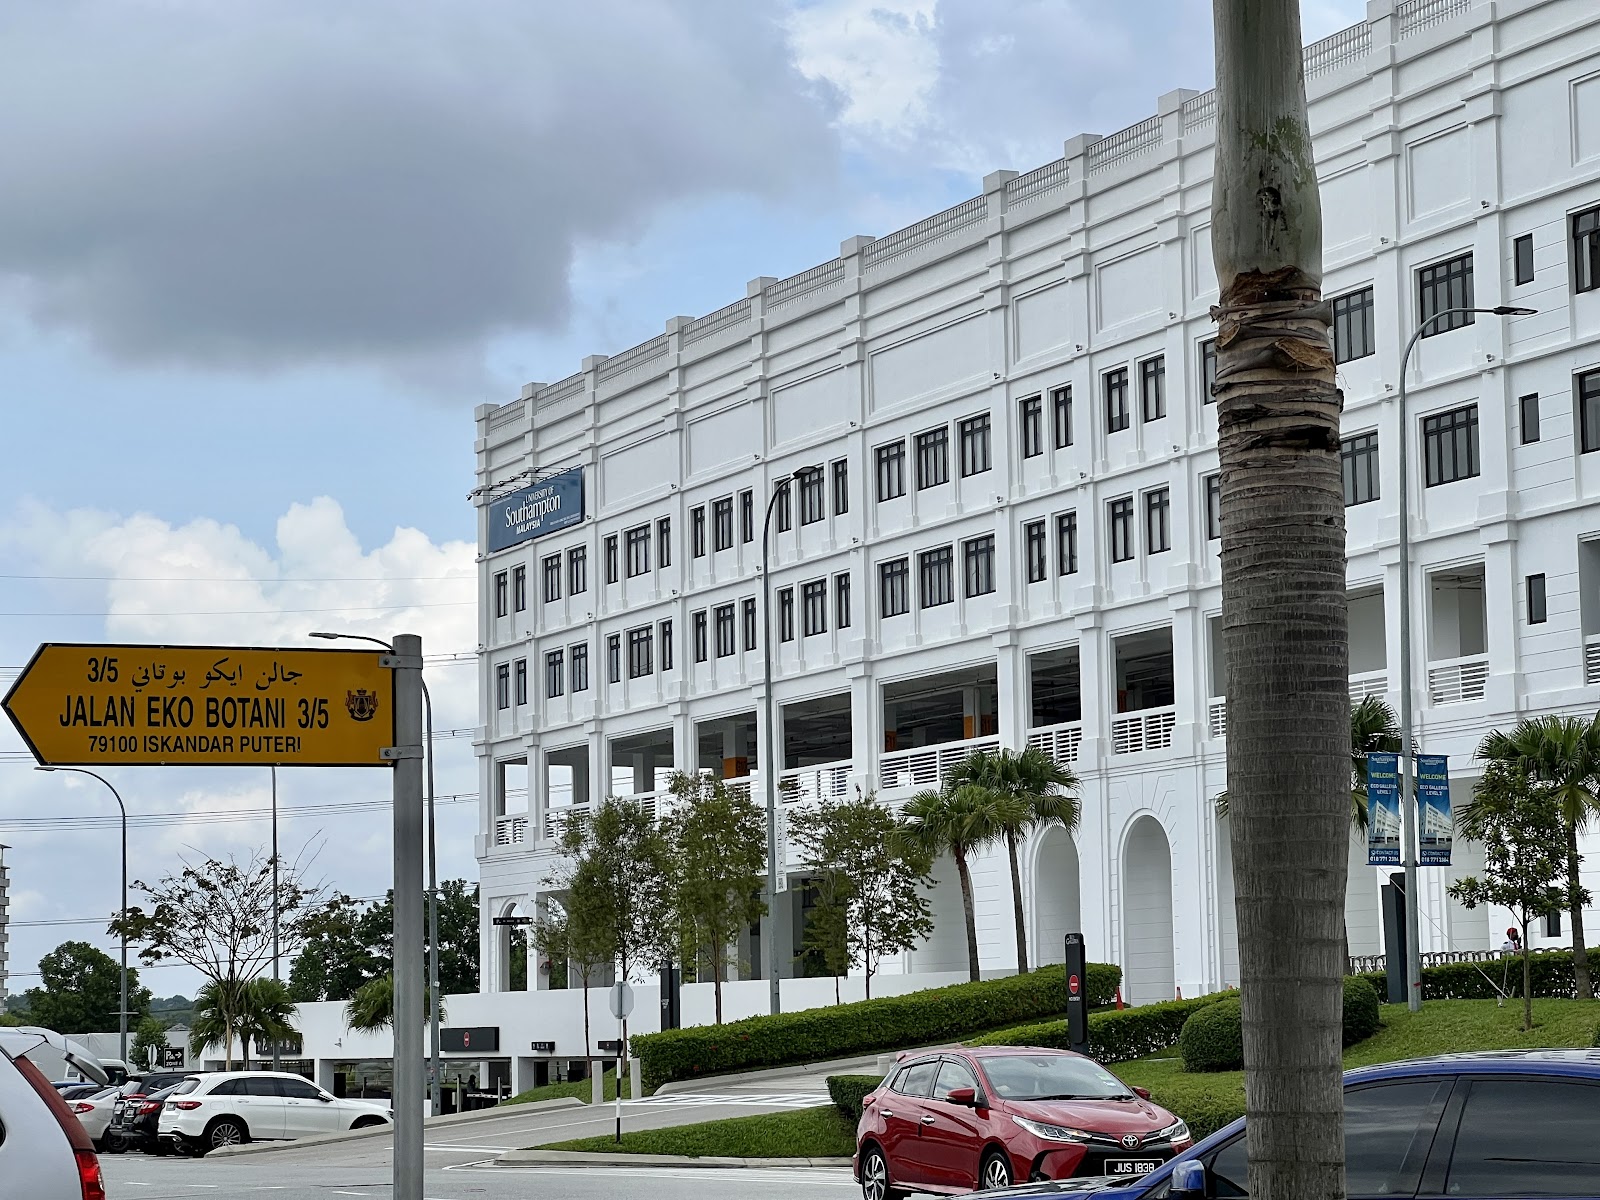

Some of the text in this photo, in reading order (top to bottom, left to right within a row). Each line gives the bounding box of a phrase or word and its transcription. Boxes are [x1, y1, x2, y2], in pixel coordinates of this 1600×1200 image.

[505, 494, 561, 528] Southampton
[516, 519, 541, 535] MALAYSIA
[87, 656, 119, 683] 3/5
[199, 656, 243, 690] ايكو
[255, 661, 303, 691] جالن
[59, 694, 329, 729] JALAN EKO BOTANI 3/5
[88, 735, 301, 753] 79100 ISKANDAR PUTERI
[166, 1051, 171, 1060] P
[1114, 1162, 1133, 1173] JUS
